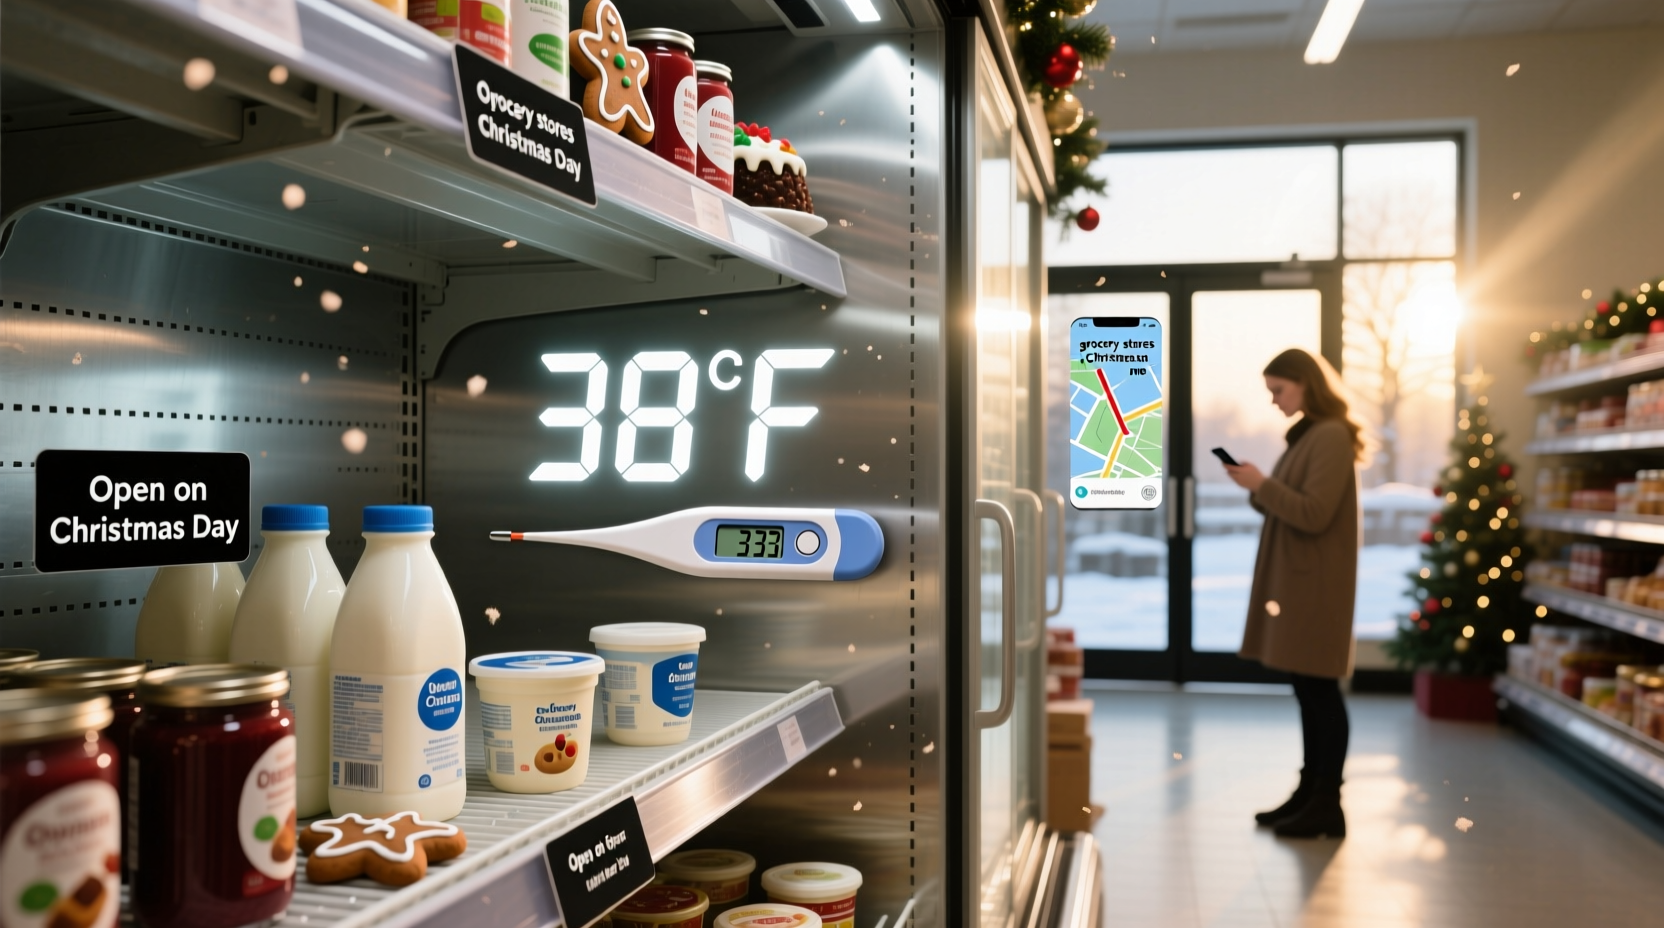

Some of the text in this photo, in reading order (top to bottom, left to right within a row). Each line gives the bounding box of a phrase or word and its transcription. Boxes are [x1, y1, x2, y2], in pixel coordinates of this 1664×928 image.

[536, 113, 575, 144] stores
[478, 113, 581, 183] Christmas Day
[89, 475, 207, 510] Open on
[50, 513, 239, 545] Christmas Day
